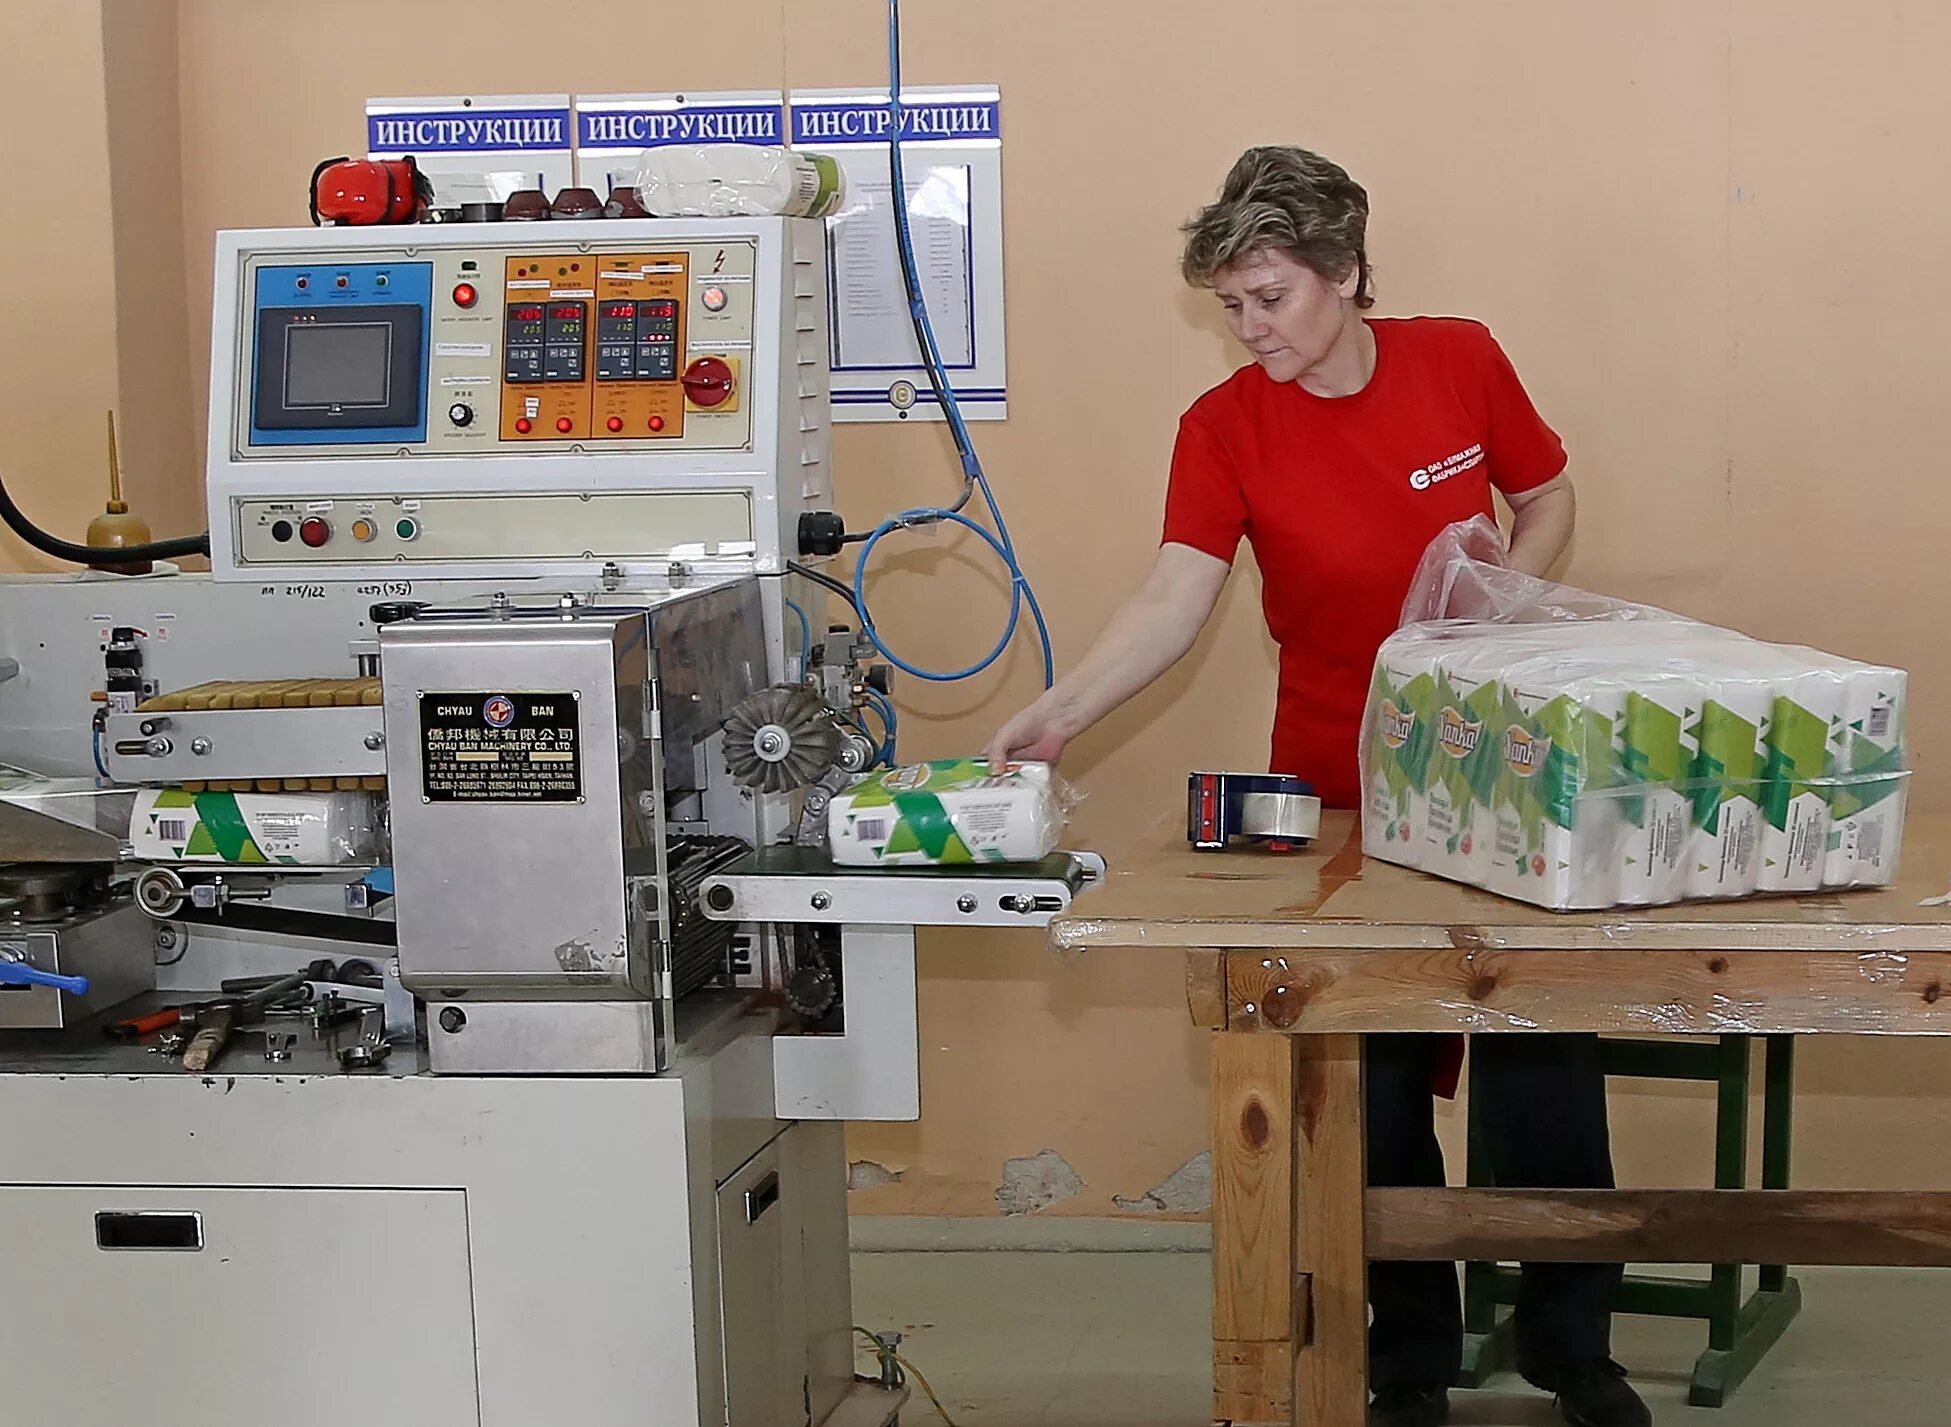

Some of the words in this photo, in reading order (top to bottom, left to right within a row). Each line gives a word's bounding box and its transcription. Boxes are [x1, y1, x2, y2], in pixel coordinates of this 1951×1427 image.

[376, 117, 563, 148] ИНСТРУКЦИИ
[587, 112, 776, 143] ИНСТРУКЦИИ
[800, 107, 991, 137] ИНСТРУКЦИИ
[437, 706, 472, 716] CHYAU
[531, 706, 554, 716] BAN
[428, 742, 456, 751] CHYAU
[459, 742, 478, 751] BAN
[480, 742, 531, 751] MACHINERY
[555, 742, 573, 751] LTD.
